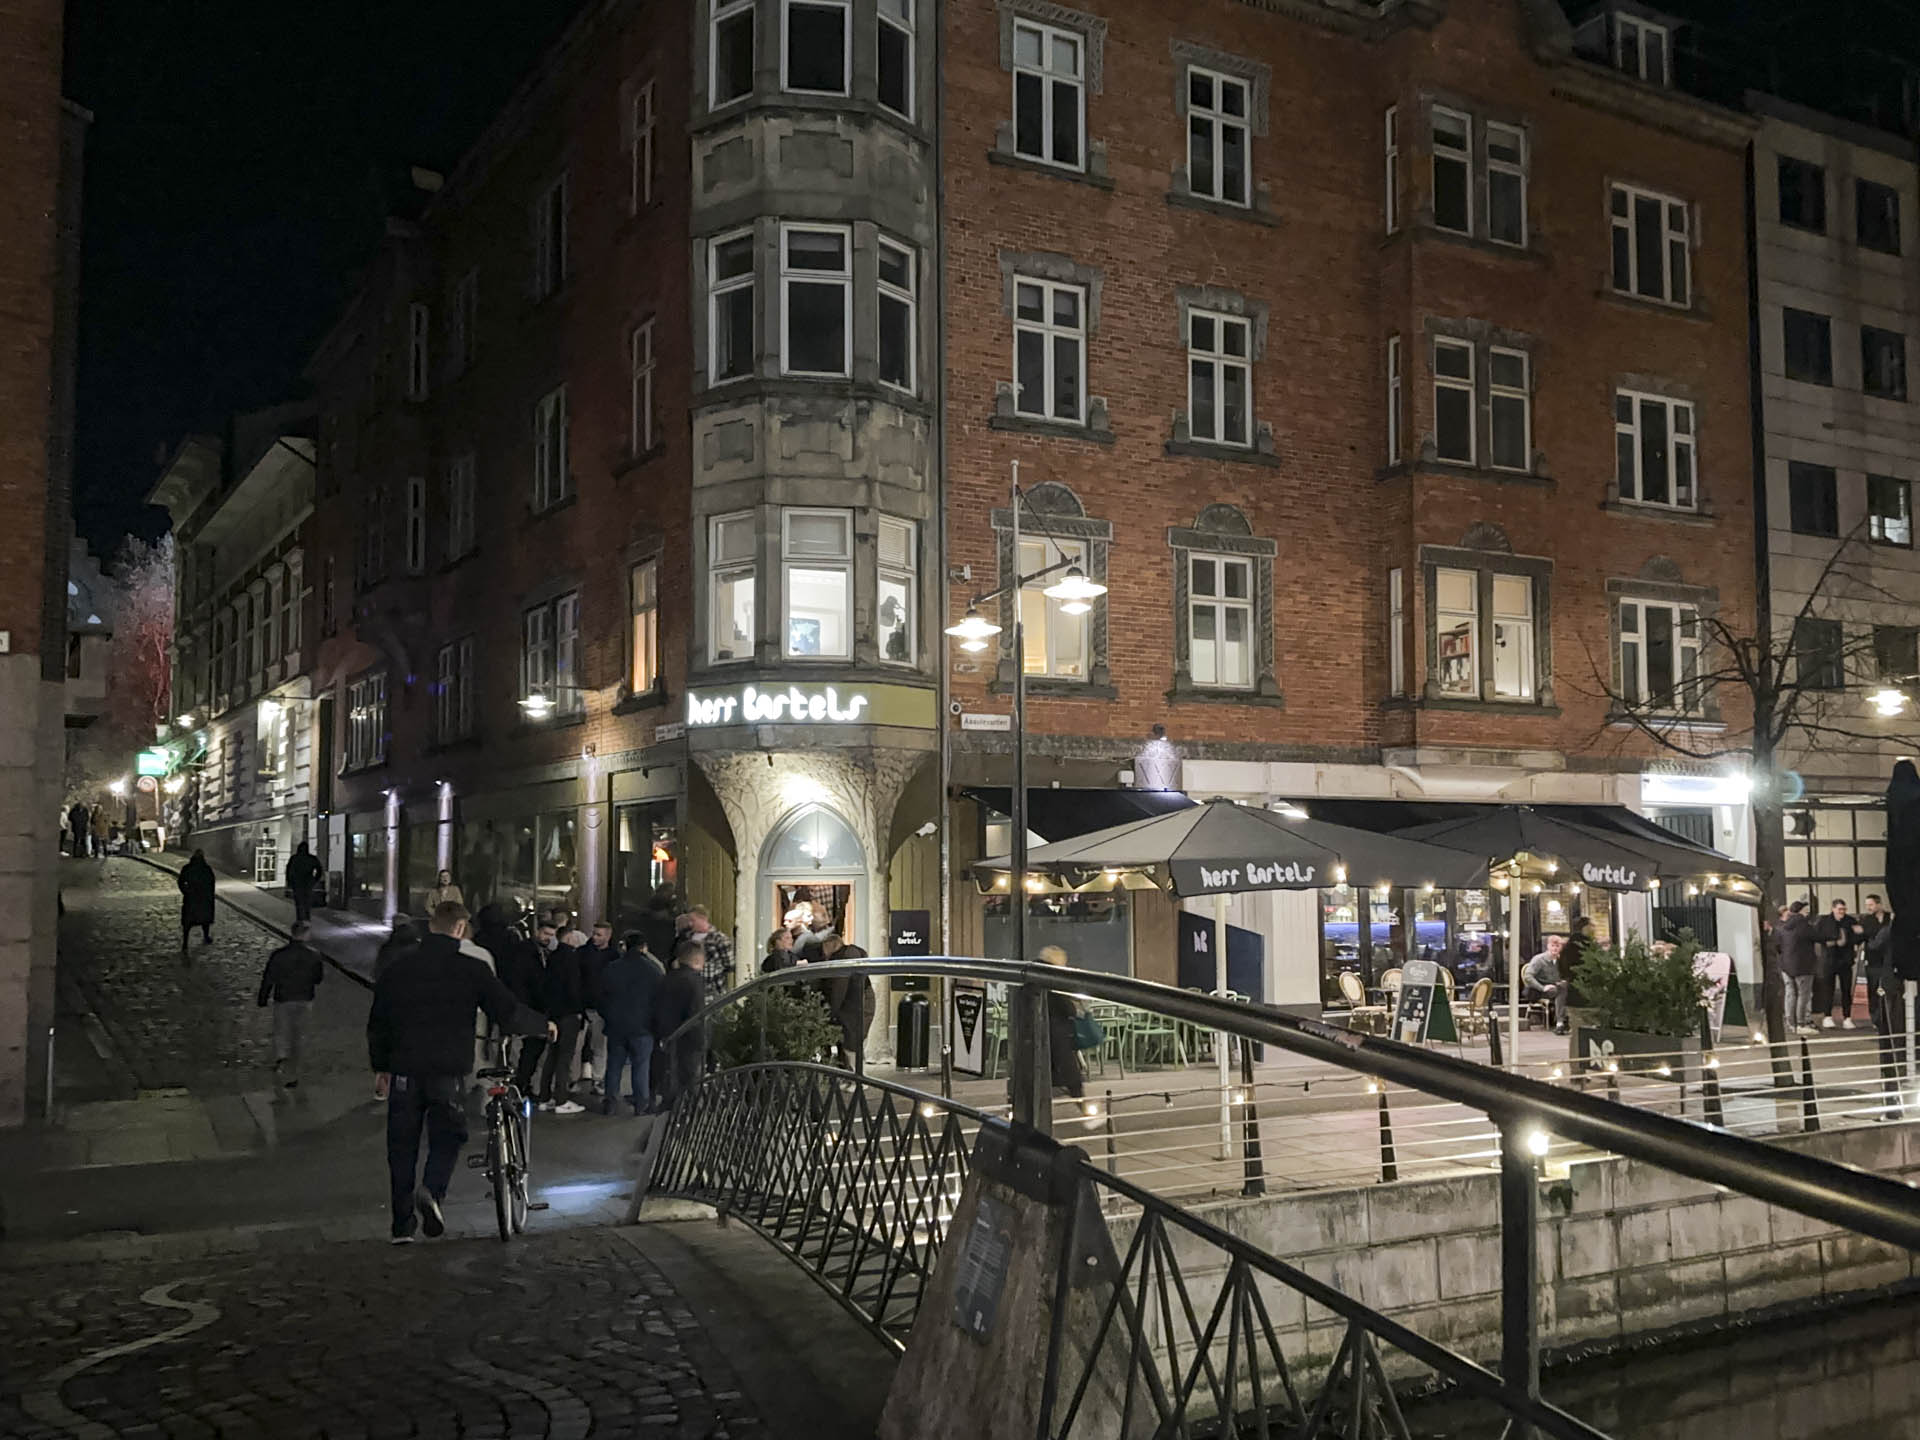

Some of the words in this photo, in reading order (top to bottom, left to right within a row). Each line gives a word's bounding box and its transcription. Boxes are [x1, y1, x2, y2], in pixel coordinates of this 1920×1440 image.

[688, 692, 737, 725] herr
[743, 686, 868, 721] Bartels
[1200, 866, 1240, 888] herr
[1246, 861, 1316, 885] Bartels
[1582, 862, 1637, 886] Bartels
